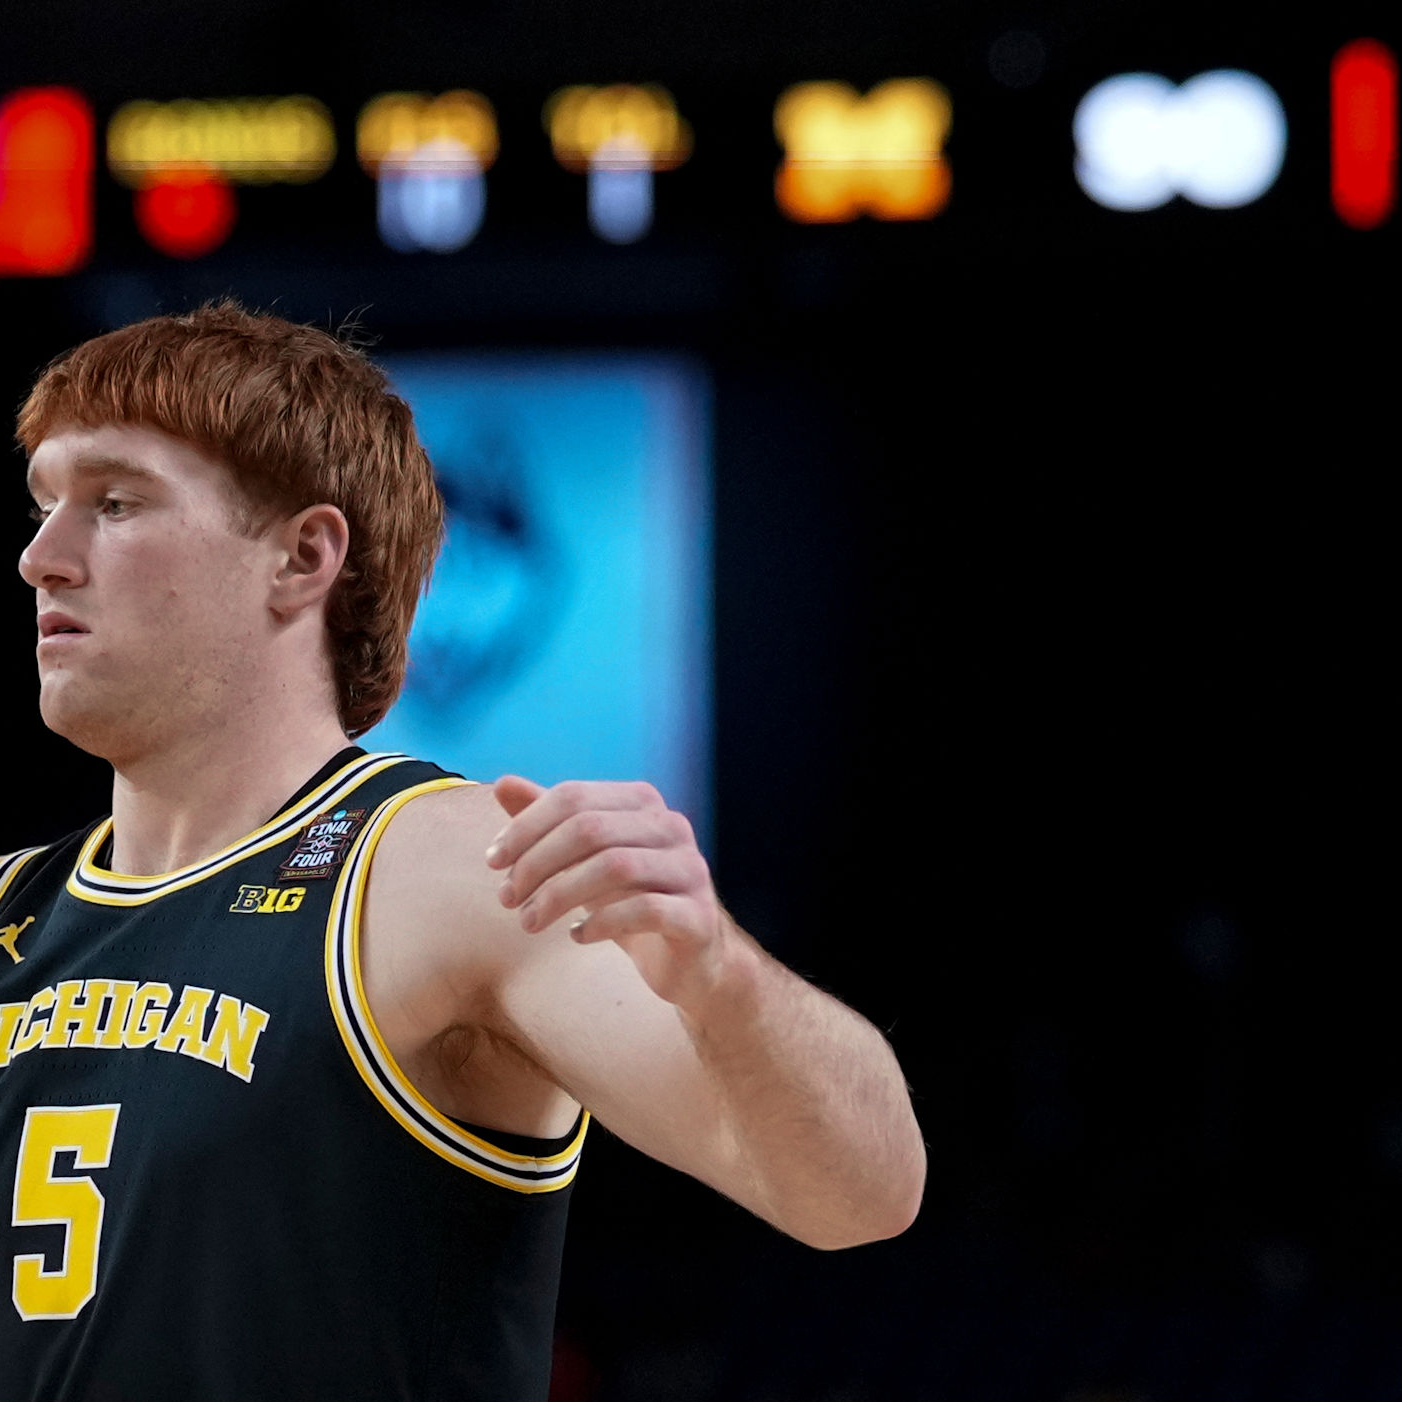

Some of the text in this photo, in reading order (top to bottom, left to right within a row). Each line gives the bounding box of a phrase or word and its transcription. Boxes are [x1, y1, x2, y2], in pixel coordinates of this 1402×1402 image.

[307, 821, 353, 839] FINAL
[288, 850, 335, 868] FOUR
[11, 1103, 122, 1322] 5
